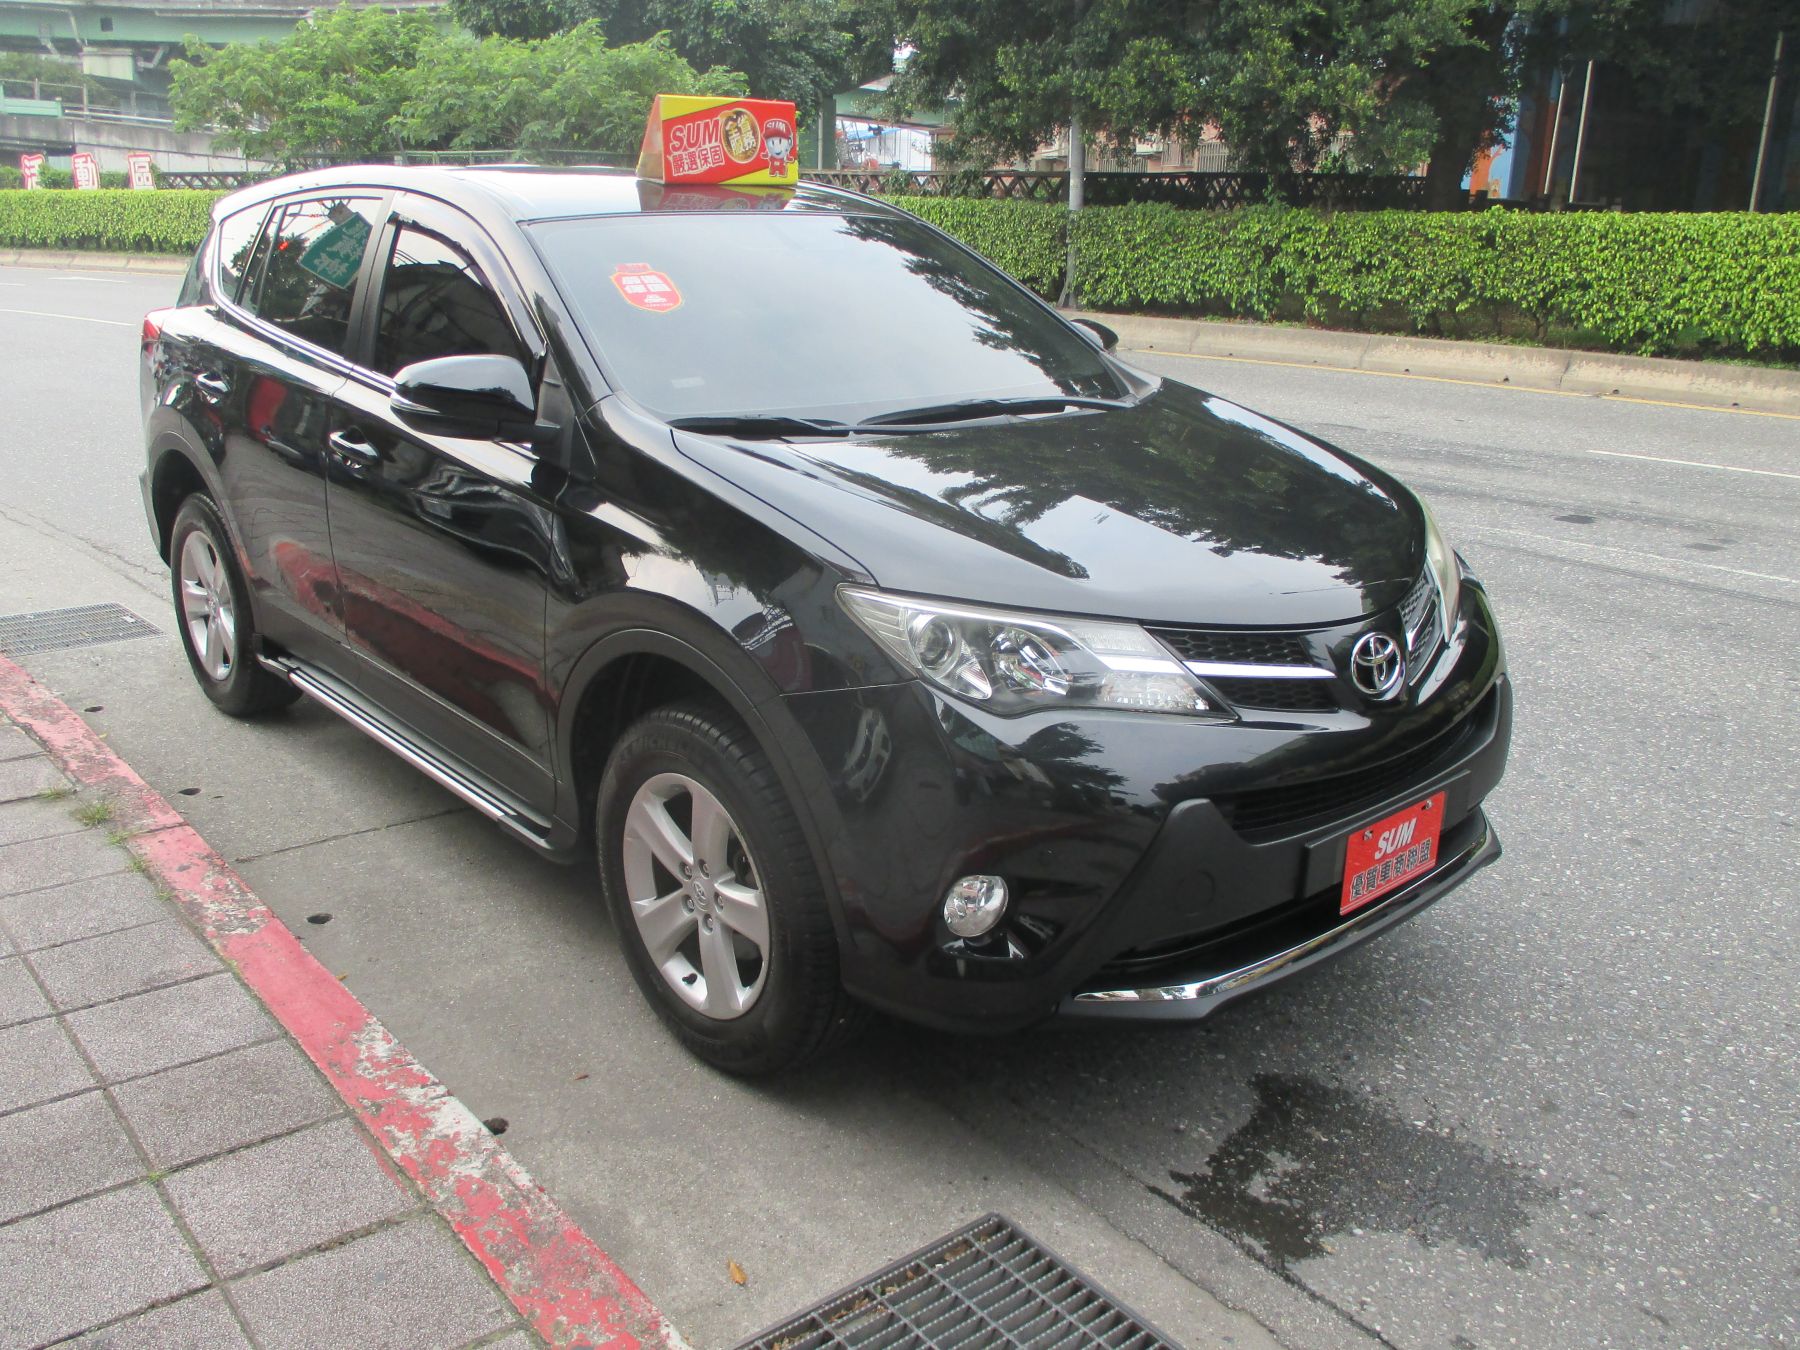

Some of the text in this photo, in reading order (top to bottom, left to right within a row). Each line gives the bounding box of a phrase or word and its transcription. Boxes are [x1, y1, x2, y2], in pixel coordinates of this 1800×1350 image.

[670, 119, 720, 152] SUM
[669, 145, 725, 176] 嚴選保固
[1374, 817, 1418, 860] SUM
[1350, 837, 1432, 901] 優質車商聯盟
